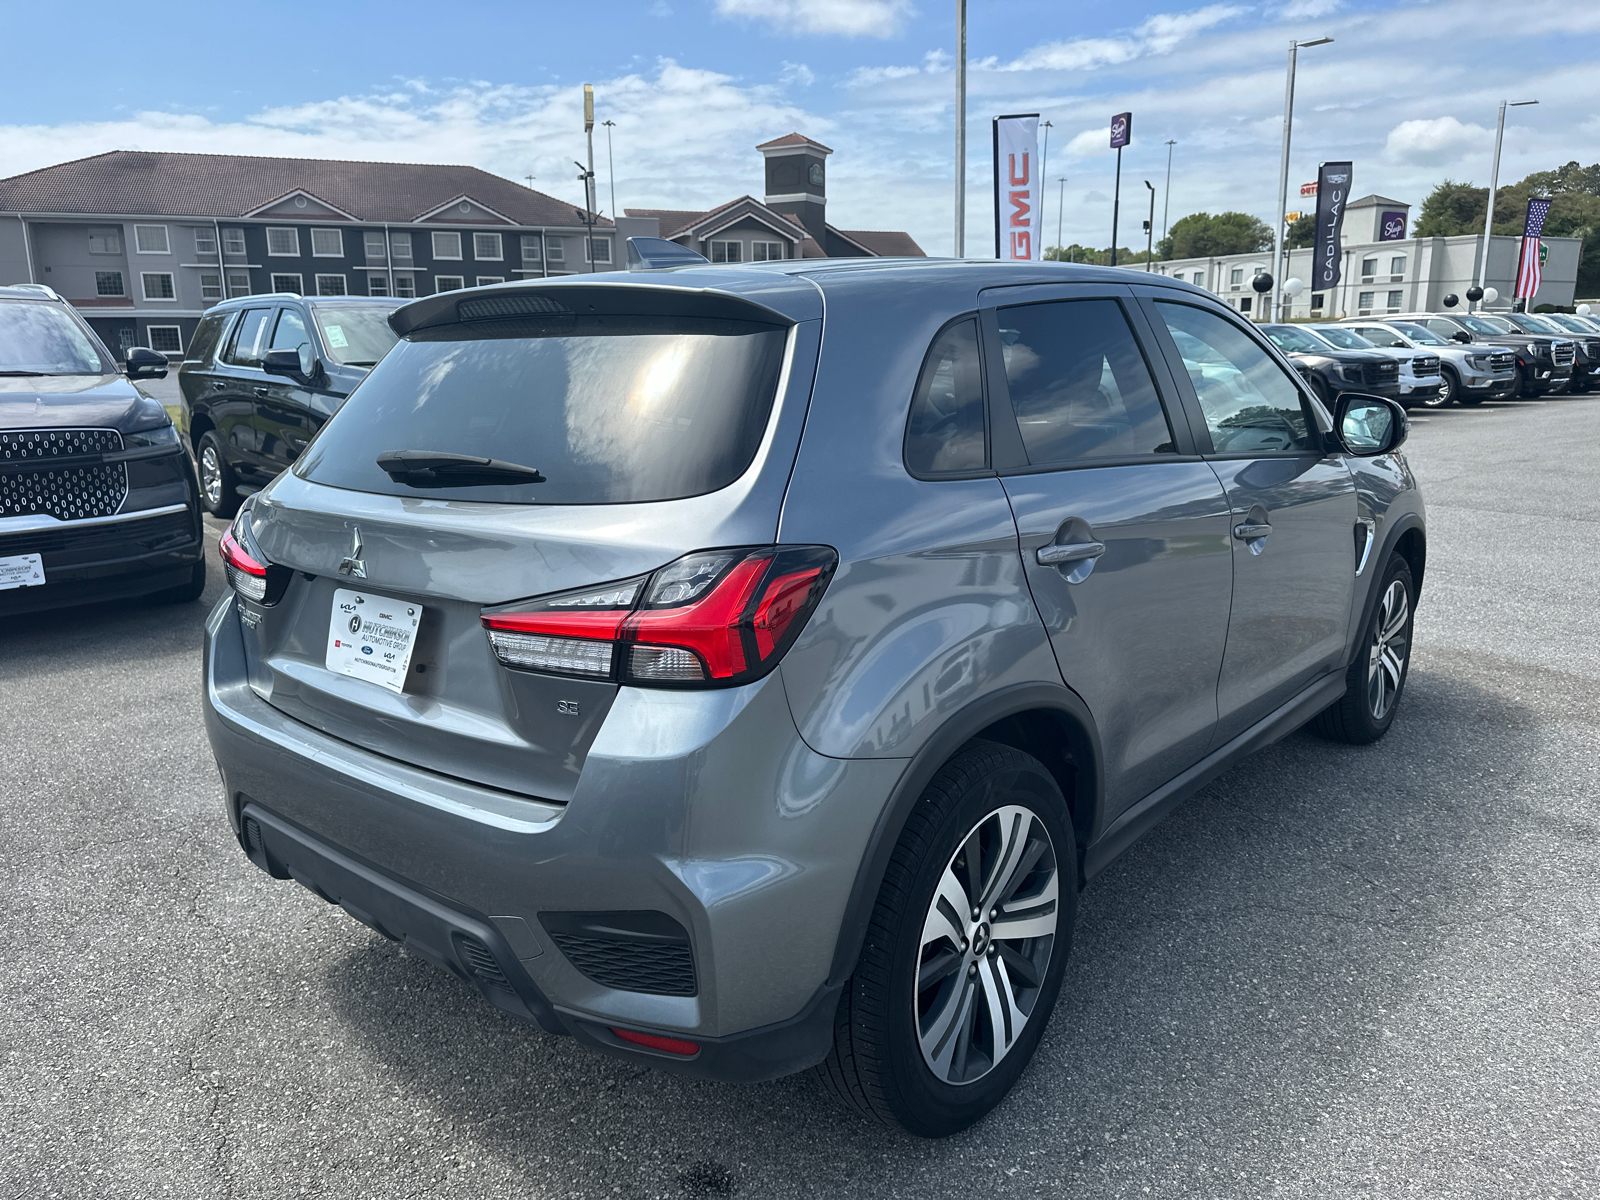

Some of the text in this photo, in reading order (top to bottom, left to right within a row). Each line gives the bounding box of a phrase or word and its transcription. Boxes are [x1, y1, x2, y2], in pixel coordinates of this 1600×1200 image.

[1009, 152, 1031, 260] GMC
[1323, 190, 1341, 282] CADILLAC
[361, 620, 412, 643] HUTCHINSON
[361, 633, 407, 651] AUTOMOTIVE GROUP
[557, 700, 580, 716] SE
